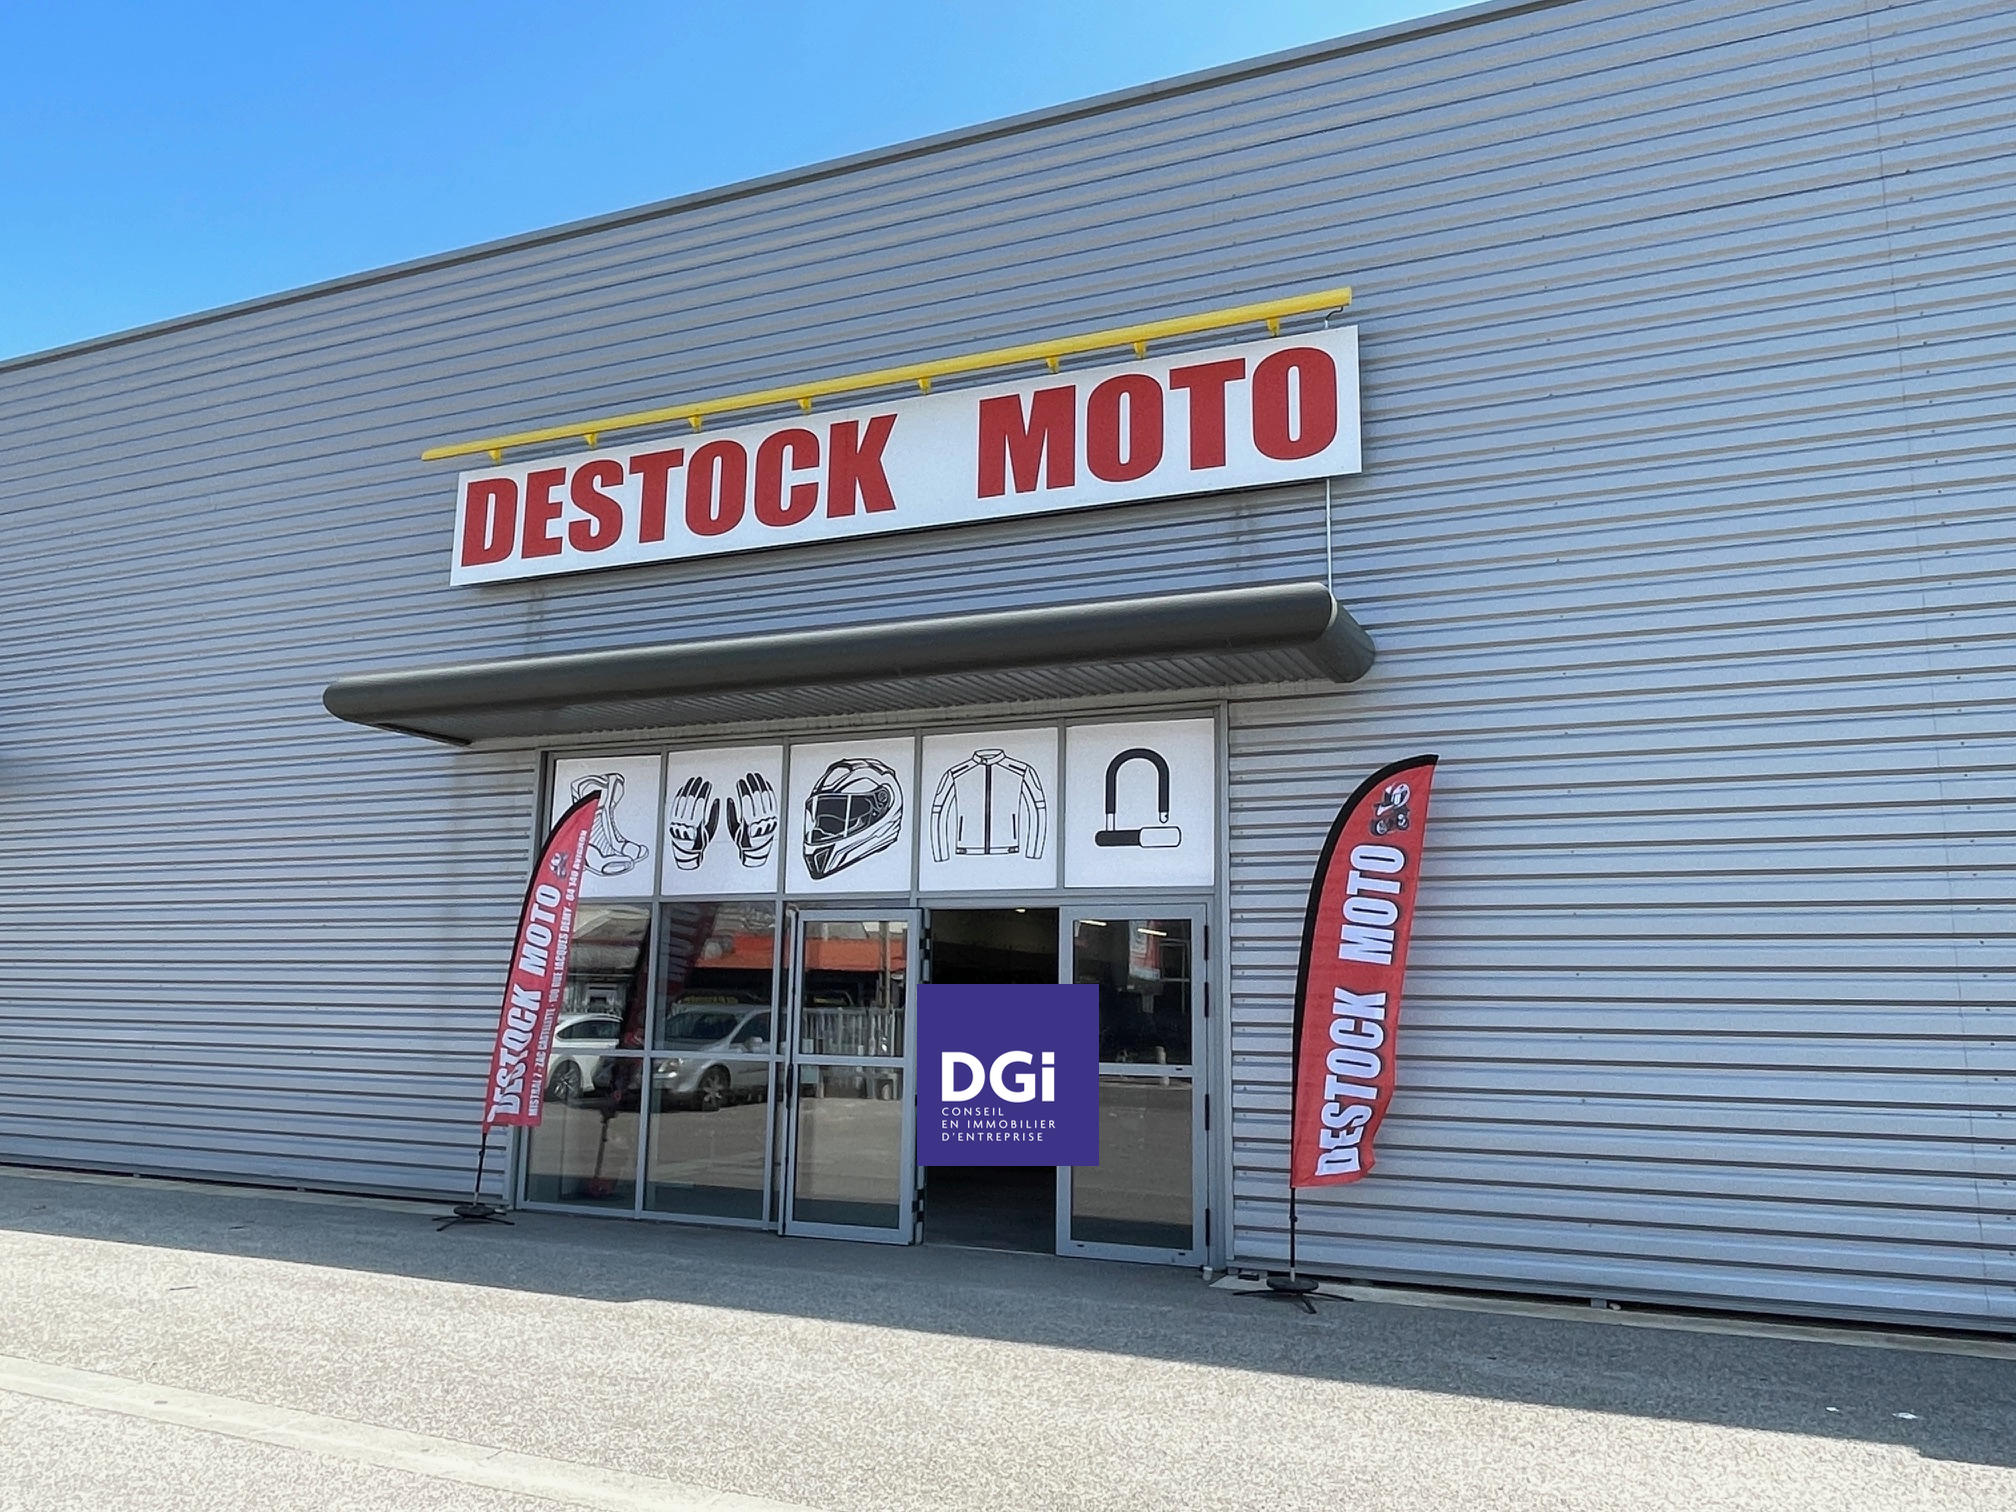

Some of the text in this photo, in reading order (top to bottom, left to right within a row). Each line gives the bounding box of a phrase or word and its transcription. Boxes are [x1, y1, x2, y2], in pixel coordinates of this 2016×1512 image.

[461, 346, 1338, 567] DESTOCK MOTO
[573, 829, 587, 869] AVIGNON
[554, 932, 569, 972] JACQUES
[560, 906, 571, 931] DEMY
[487, 884, 561, 1122] DESTOCK MOTO
[1315, 844, 1406, 1176] DESTOCK MOTO
